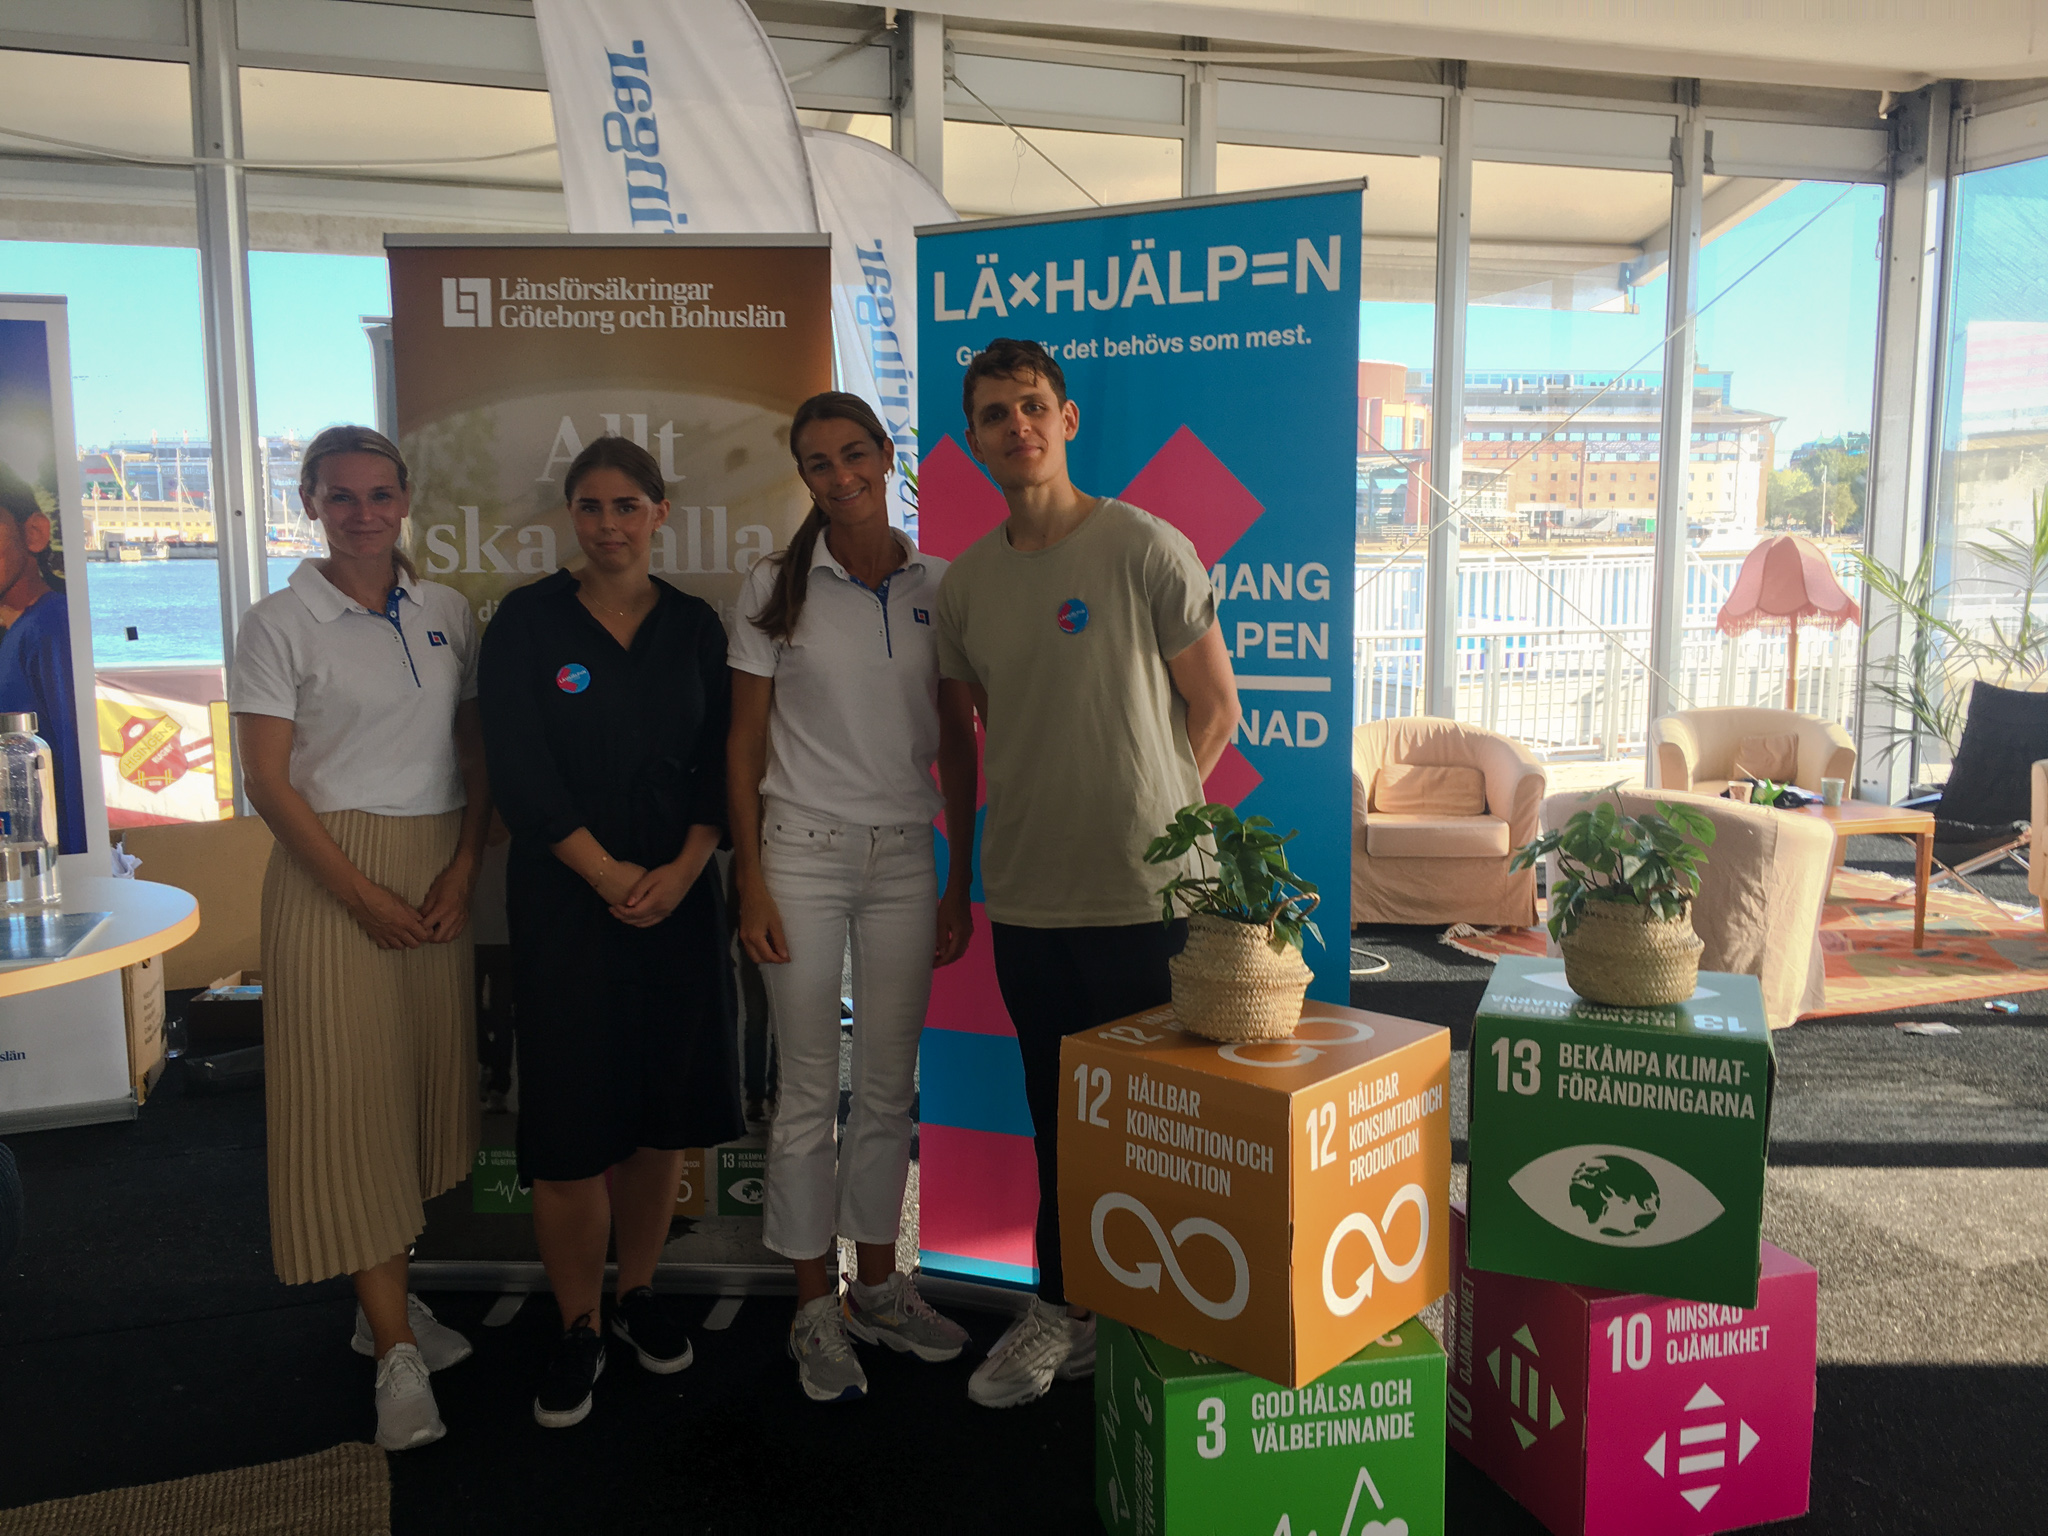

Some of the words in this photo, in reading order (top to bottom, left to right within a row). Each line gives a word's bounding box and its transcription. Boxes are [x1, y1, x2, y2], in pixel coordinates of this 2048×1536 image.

[499, 277, 714, 305] Länsförsäkringar
[500, 304, 616, 334] Göteborg
[619, 304, 667, 328] och
[669, 304, 787, 328] Bohuslän
[1062, 338, 1099, 360] det
[1104, 334, 1184, 357] behövs
[1189, 330, 1239, 352] som
[1245, 324, 1312, 348] mest.
[535, 413, 687, 483] At
[425, 505, 563, 575] ska
[1229, 621, 1329, 660] PEN
[123, 722, 174, 769] HISINGENS
[151, 743, 174, 764] RUGBY
[1098, 1025, 1165, 1045] 12
[1491, 1036, 1542, 1096] 13
[1559, 1041, 1661, 1078] BEKÄMPA
[1665, 1053, 1750, 1086] KLIMAT-
[1074, 1063, 1112, 1129] 12
[1128, 1072, 1201, 1118] HÅLLBAR
[1305, 1101, 1337, 1172] 12
[1348, 1071, 1399, 1118] HÅLLBAR
[1349, 1100, 1420, 1152] KONSUMTION
[1421, 1083, 1443, 1117] OCH
[1558, 1072, 1756, 1120] FÖRÄNDRINGARNA
[478, 1151, 486, 1166] 3
[722, 1152, 735, 1168] 13
[1126, 1108, 1234, 1163] KONSUMTION
[1236, 1142, 1274, 1174] OCH
[1349, 1127, 1420, 1187] PRODUKTION
[1125, 1141, 1231, 1197] PRODUKTION
[1459, 1273, 1474, 1386] OJÄMLIKHET
[1607, 1312, 1652, 1374] 10
[1666, 1302, 1743, 1334] MINSKAD
[1666, 1325, 1770, 1365] OJÄMLIKHET
[1196, 1397, 1227, 1460] 3
[1251, 1390, 1295, 1420] GOD
[1300, 1382, 1366, 1417] HÄLSA
[1370, 1378, 1412, 1409] OCH
[1251, 1412, 1415, 1454] VÄLBEFINNANDE
